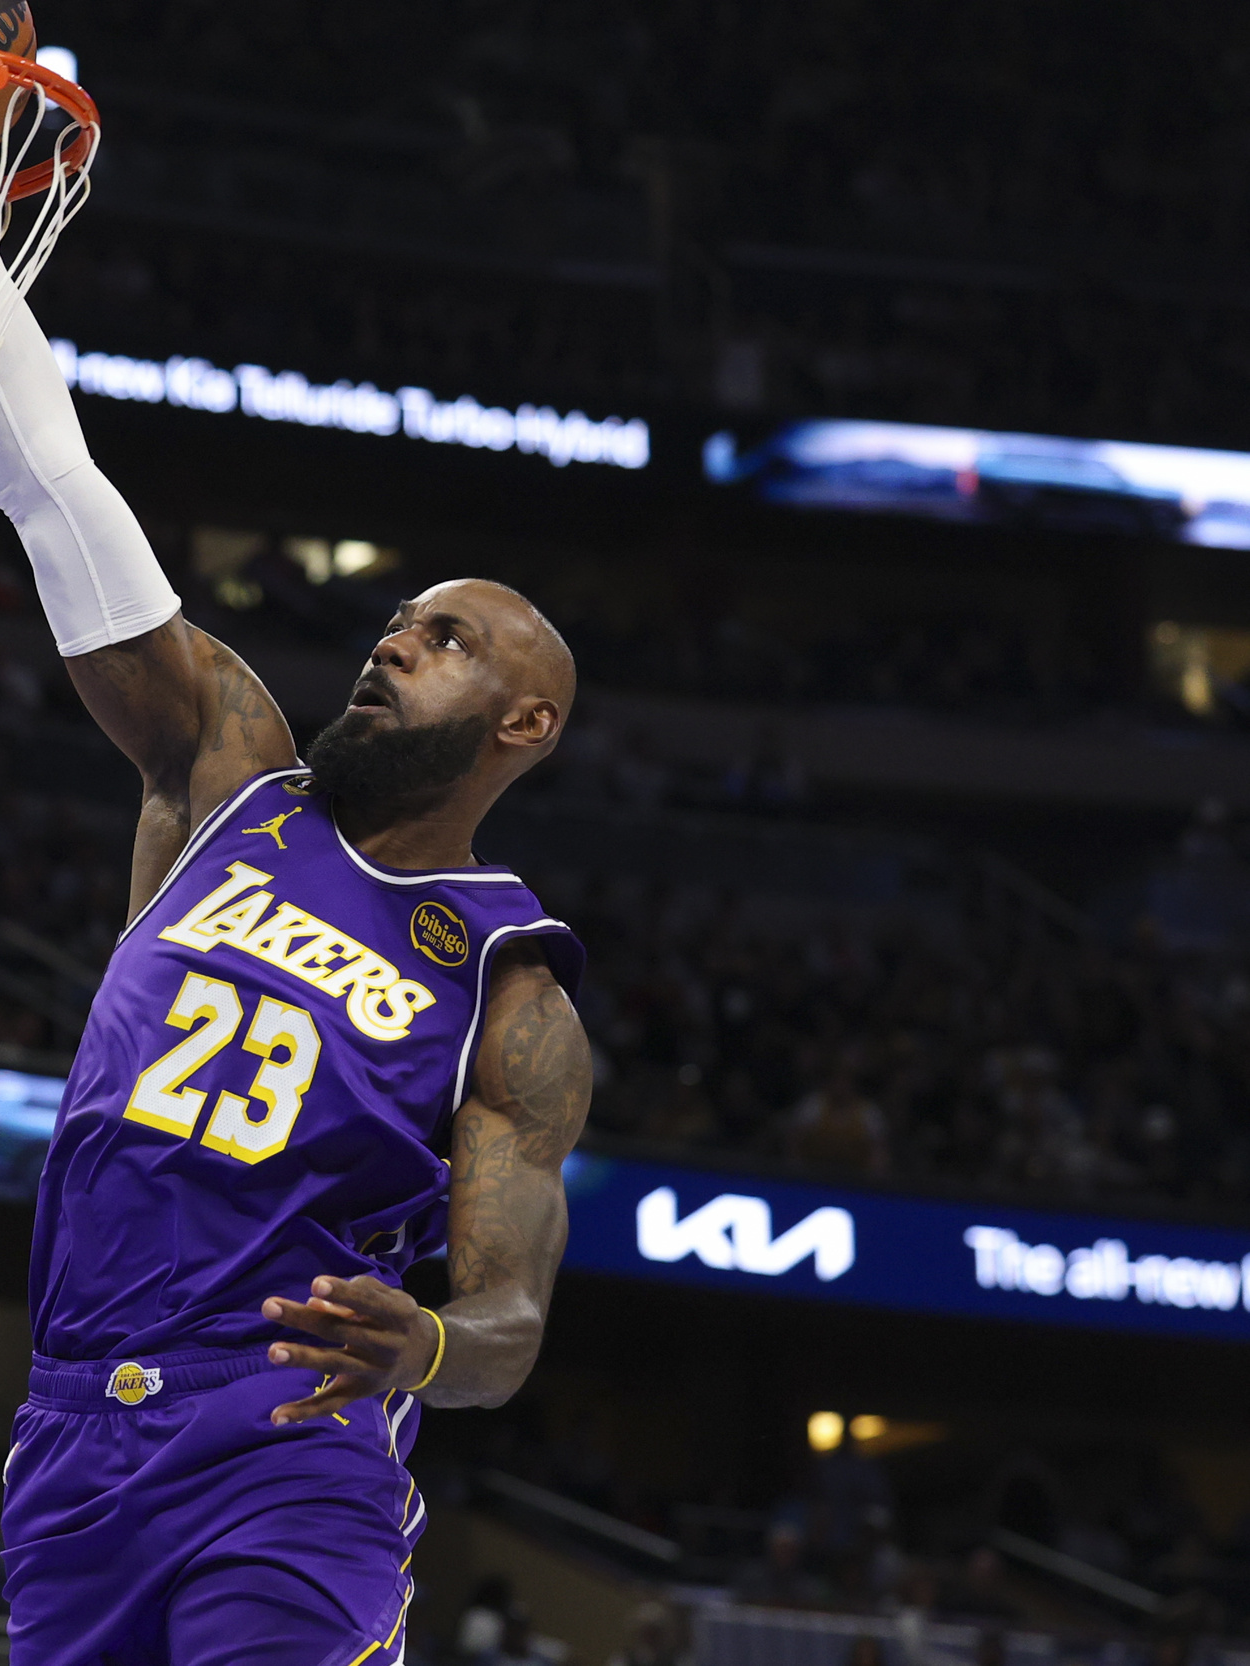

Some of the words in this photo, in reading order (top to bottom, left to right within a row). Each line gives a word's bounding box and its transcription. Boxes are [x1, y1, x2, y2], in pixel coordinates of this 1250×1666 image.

[158, 860, 437, 1042] LAKERS
[417, 908, 466, 955] bibigo
[421, 930, 444, 951] 비비고
[122, 970, 322, 1166] 23
[637, 1187, 855, 1281] KIA
[963, 1225, 1066, 1296] The
[1065, 1237, 1241, 1311] all-new
[108, 1374, 161, 1395] LAKERS
